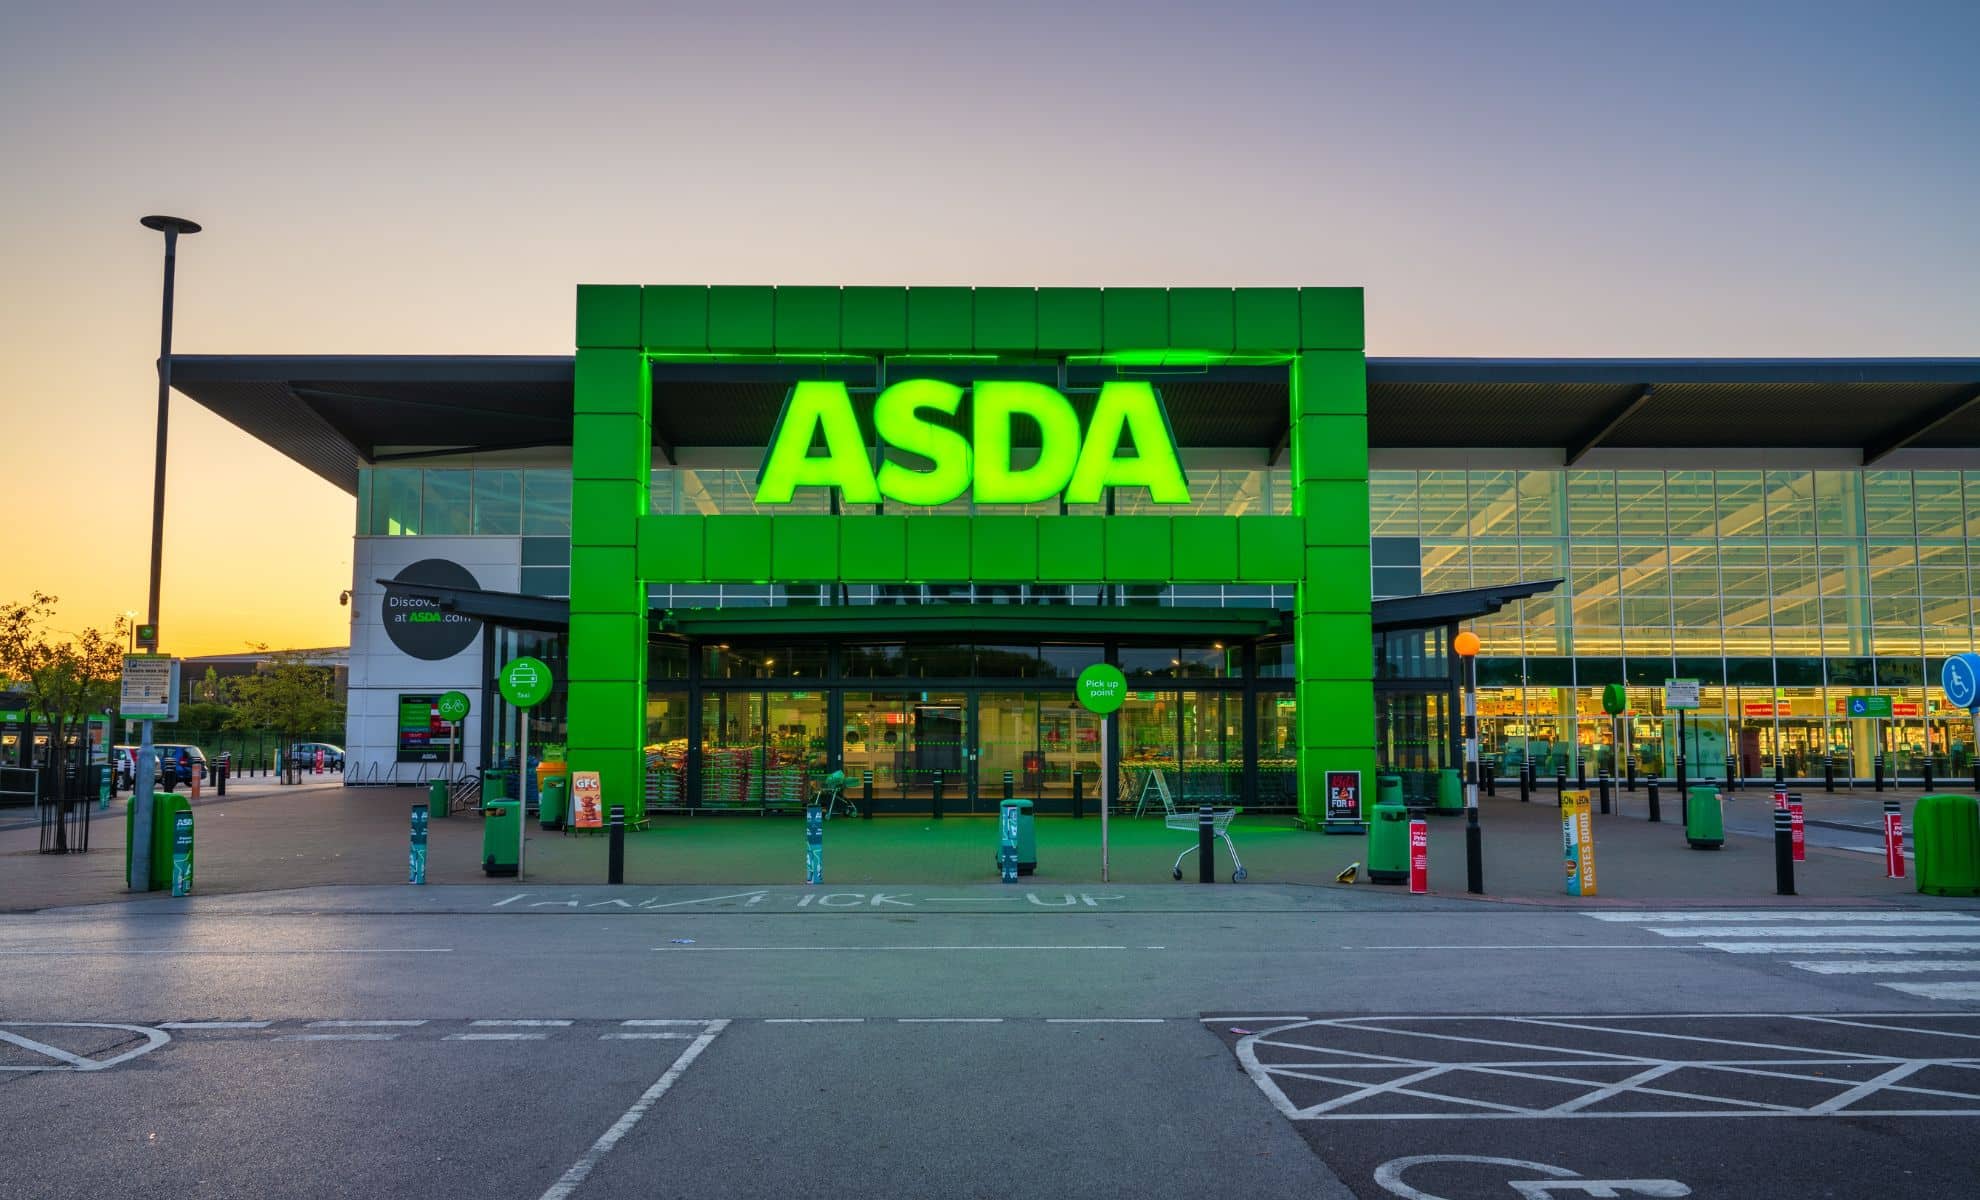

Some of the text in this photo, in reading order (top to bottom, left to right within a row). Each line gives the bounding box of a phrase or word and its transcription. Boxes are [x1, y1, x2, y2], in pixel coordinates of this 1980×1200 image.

[755, 379, 1192, 506] ASDA
[390, 597, 441, 607] Discov
[395, 613, 407, 622] at
[1086, 680, 1119, 689] Pick up
[1090, 689, 1114, 699] point
[576, 779, 598, 788] GFC
[1332, 800, 1348, 808] FOR
[1582, 846, 1593, 889] TASTES
